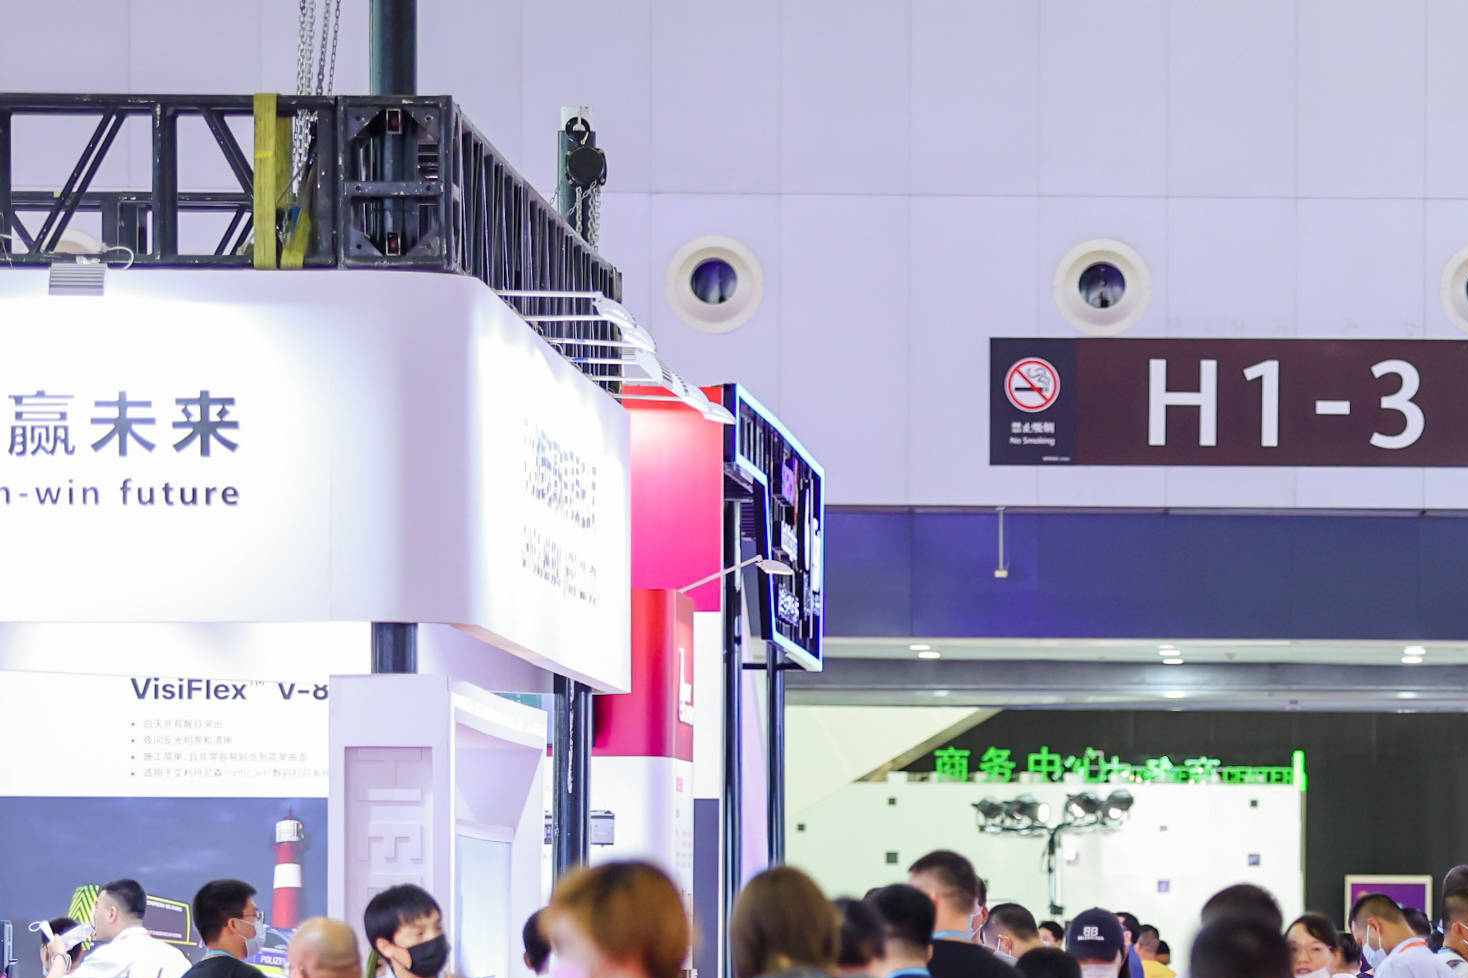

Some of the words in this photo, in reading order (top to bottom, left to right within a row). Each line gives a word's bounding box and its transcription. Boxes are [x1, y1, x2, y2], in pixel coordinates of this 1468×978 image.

[8, 390, 240, 457] 赢未来
[1148, 358, 1425, 450] H1-3
[120, 478, 240, 506] future
